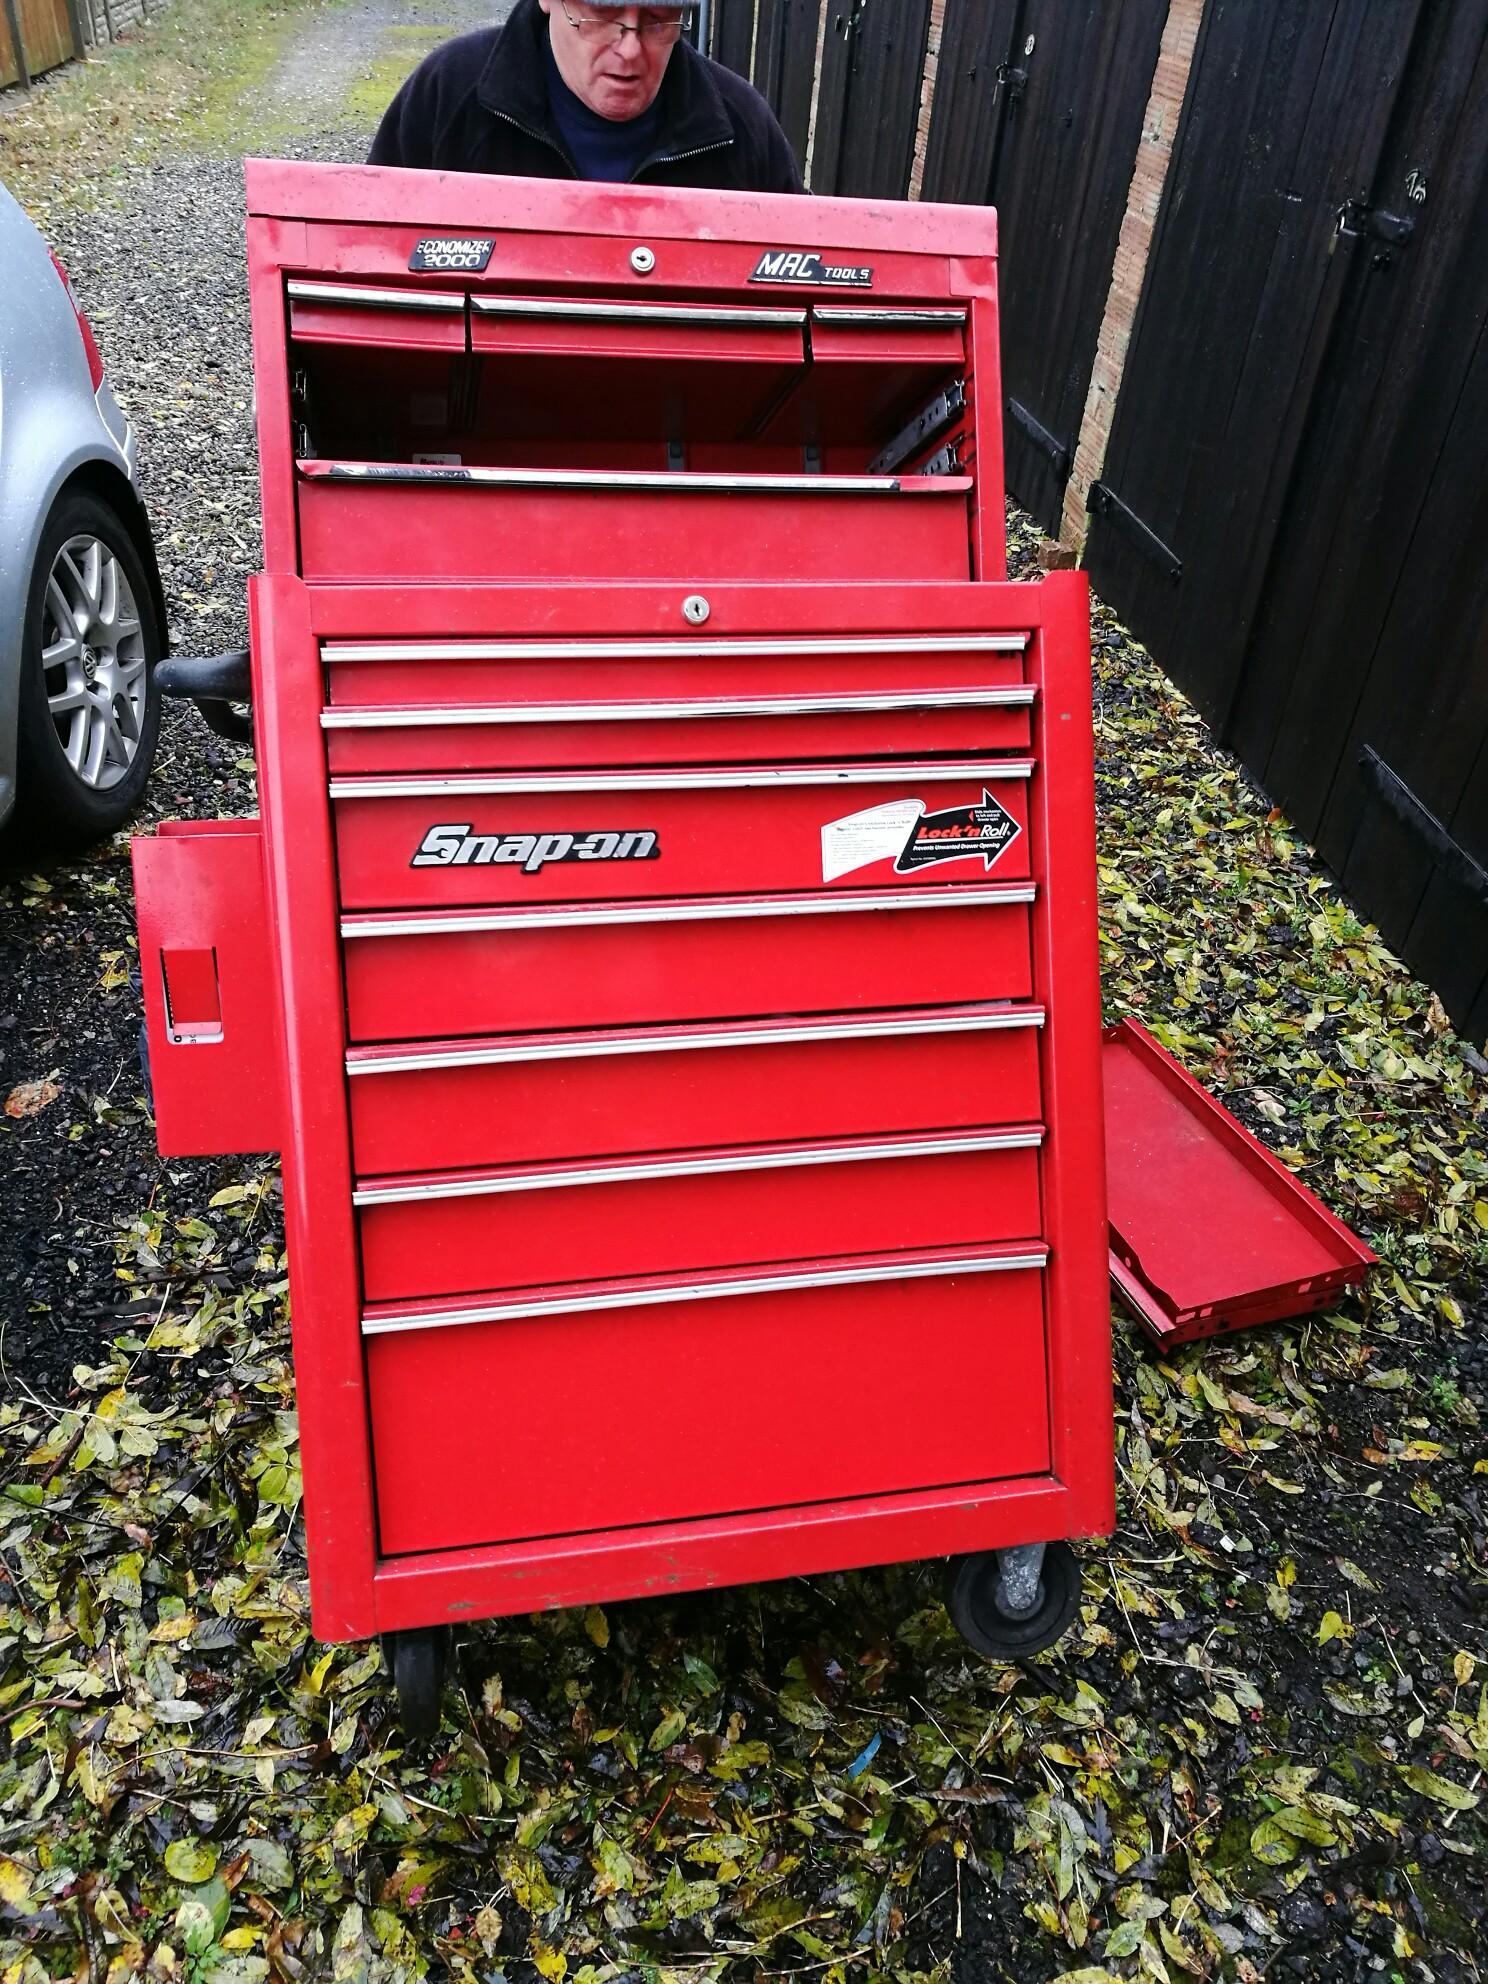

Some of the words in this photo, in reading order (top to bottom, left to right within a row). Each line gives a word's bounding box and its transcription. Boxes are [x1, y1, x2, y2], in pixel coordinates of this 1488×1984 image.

[416, 240, 491, 254] ECONOMIZER
[424, 253, 481, 268] 2000
[756, 252, 821, 278] MAC
[824, 266, 870, 280] TOOLS
[411, 824, 657, 871] Snap-on
